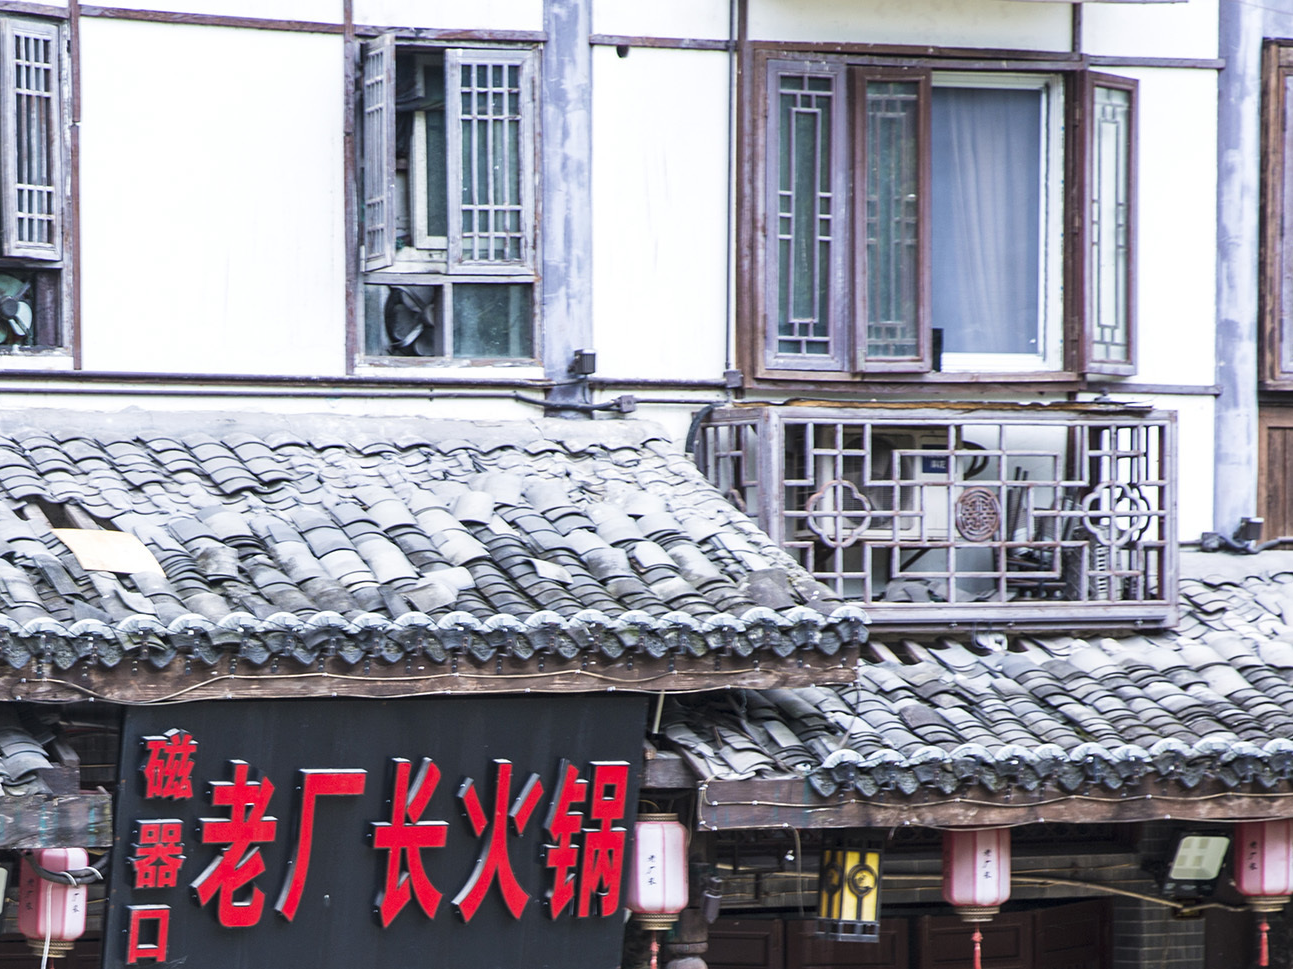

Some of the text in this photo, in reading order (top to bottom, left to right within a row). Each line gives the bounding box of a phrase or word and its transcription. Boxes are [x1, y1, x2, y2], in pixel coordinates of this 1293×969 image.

[125, 731, 198, 965] 磁器口
[193, 759, 630, 928] 老厂长火锅
